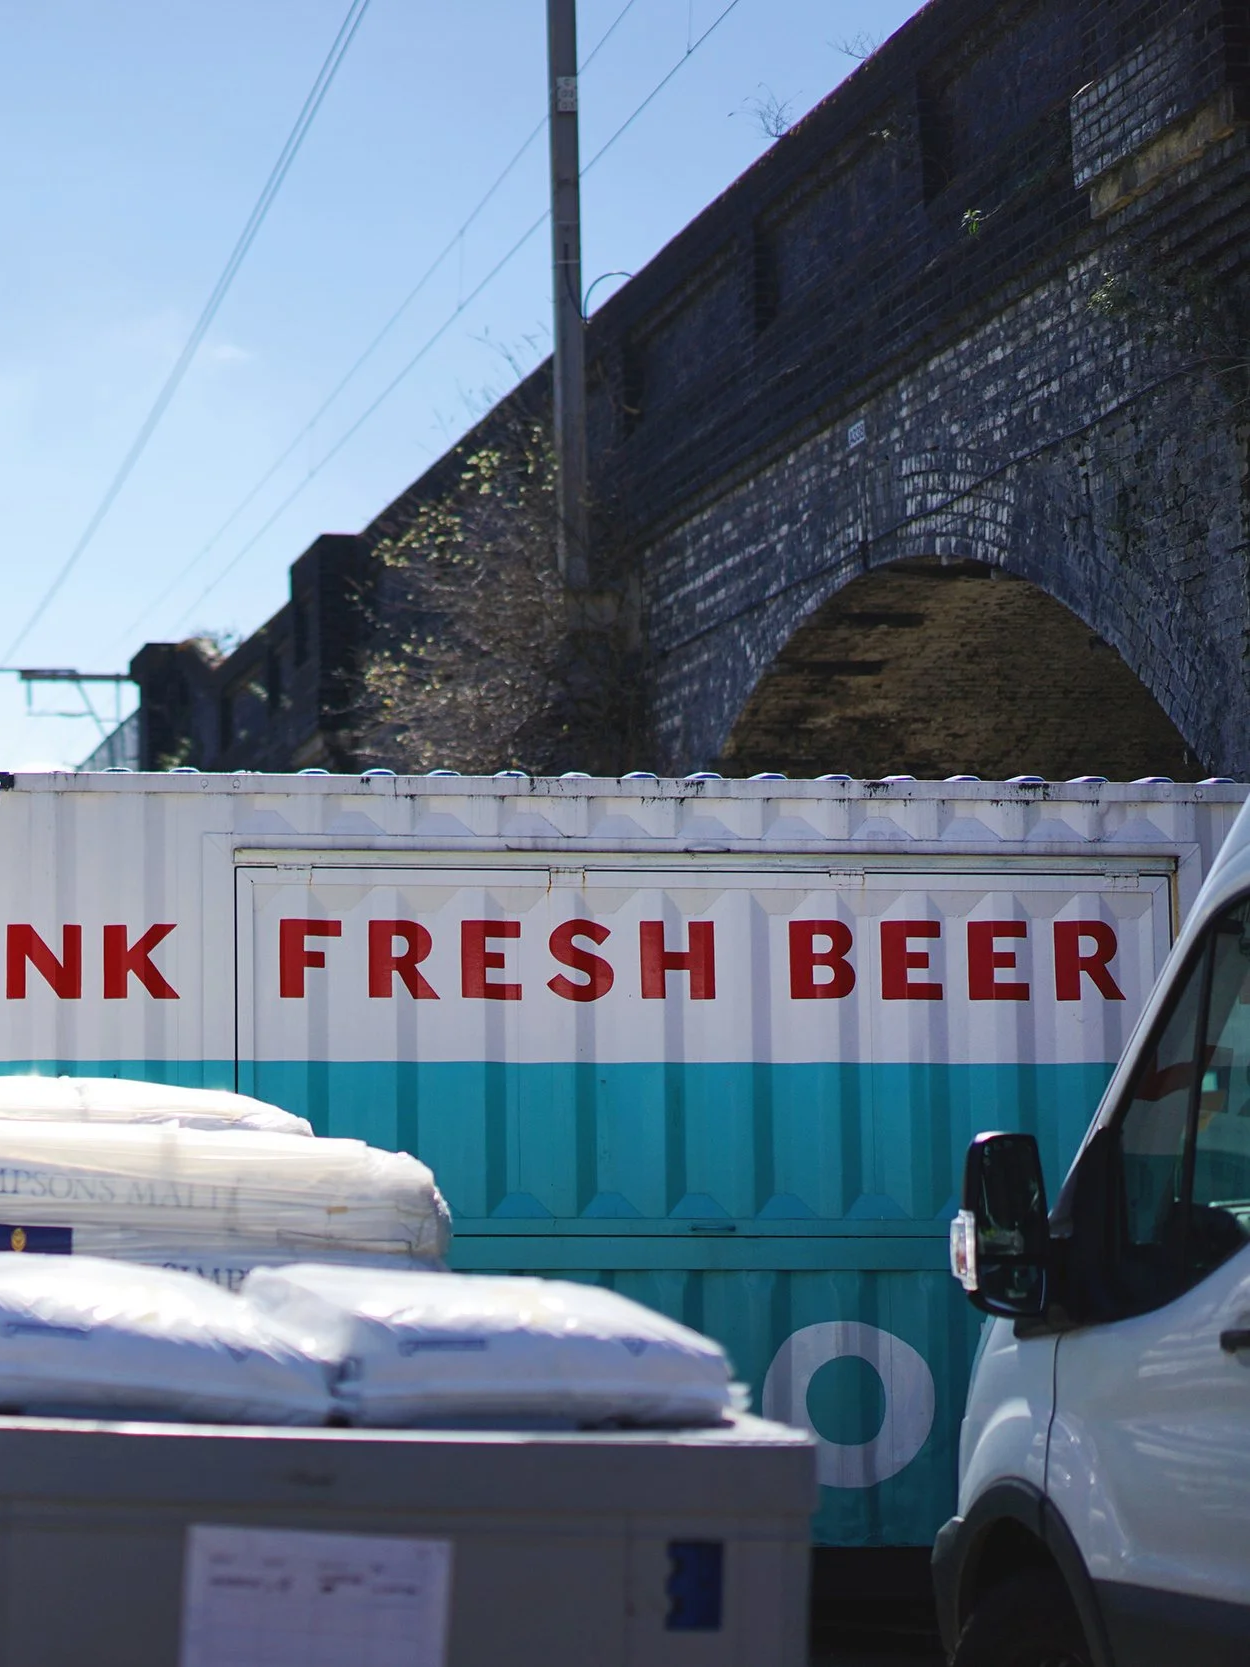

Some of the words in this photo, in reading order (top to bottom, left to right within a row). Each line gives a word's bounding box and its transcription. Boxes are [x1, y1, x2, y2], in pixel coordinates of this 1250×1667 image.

[279, 918, 716, 1002] FRESH
[788, 918, 1127, 1001] BEER
[125, 1177, 226, 1212] MALT
